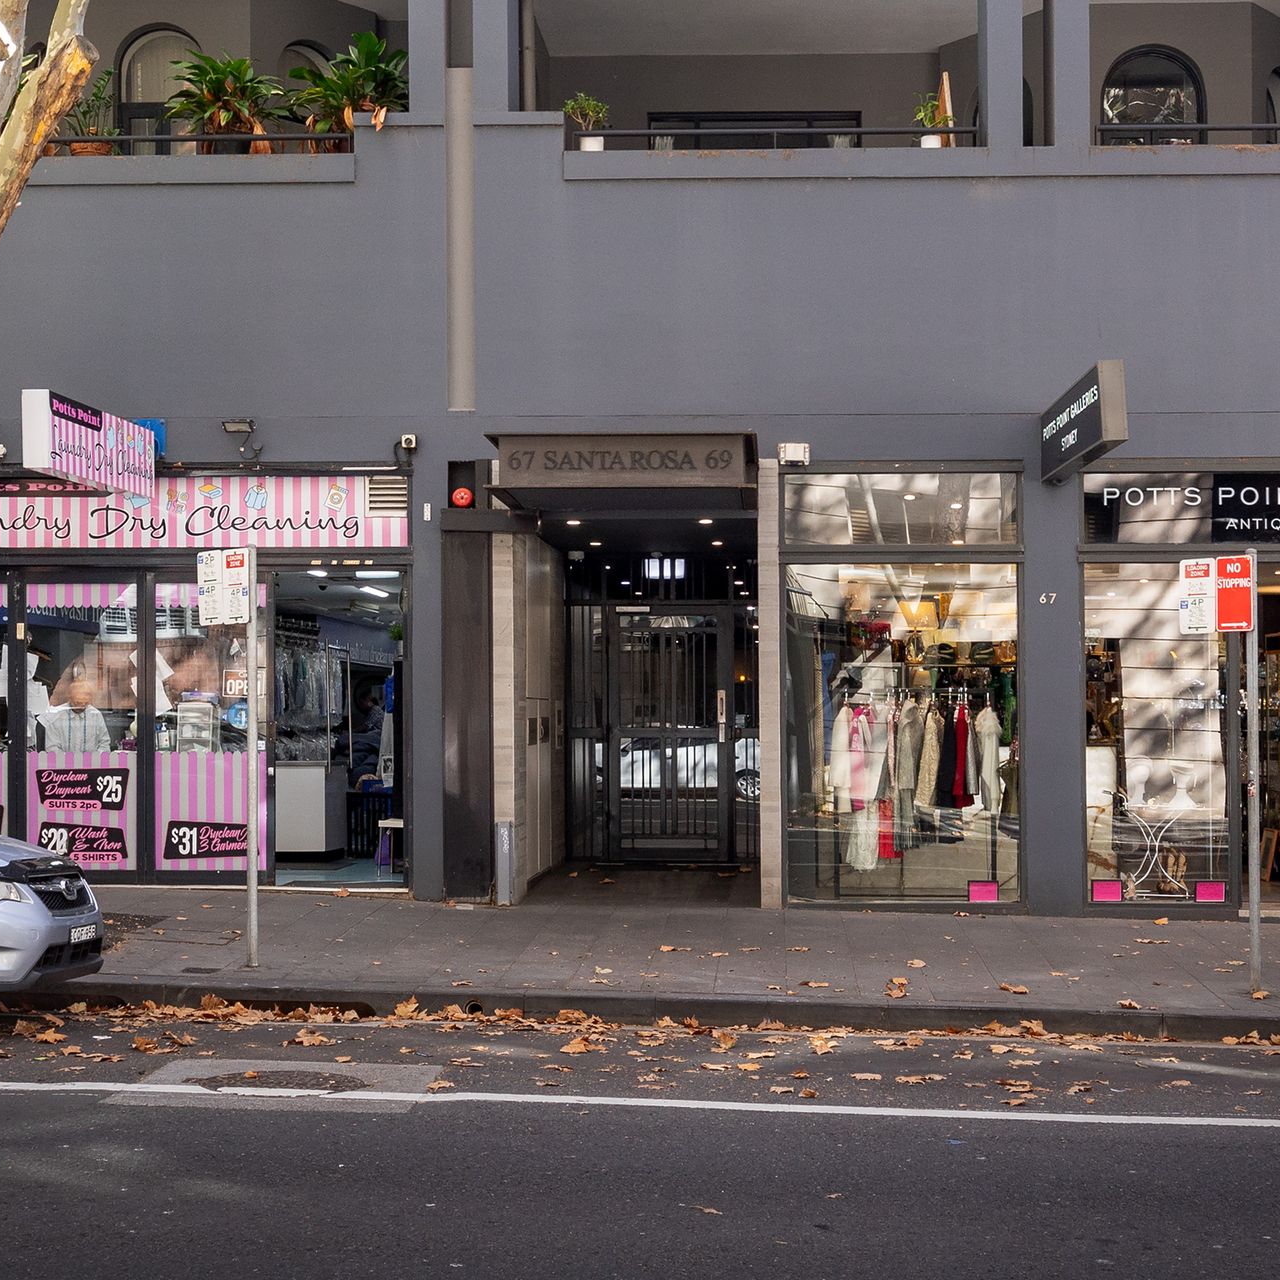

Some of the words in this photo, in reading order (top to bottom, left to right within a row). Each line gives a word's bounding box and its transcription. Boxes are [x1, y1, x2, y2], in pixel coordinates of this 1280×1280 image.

[51, 398, 77, 419] Potts
[77, 407, 102, 428] Point
[1056, 407, 1070, 431] POINT
[1070, 385, 1099, 419] GALLERIES
[50, 424, 92, 470] Laundry
[94, 443, 114, 476] Dry
[117, 449, 154, 489] Cleaning
[508, 449, 536, 470] 67
[543, 449, 626, 470] SANTA
[628, 449, 698, 470] ROSA
[704, 449, 734, 470] 69
[26, 478, 95, 492] Poin
[1102, 487, 1202, 506] POTTS
[88, 504, 167, 539] Dry
[185, 504, 359, 539] Cleaning
[1226, 563, 1242, 573] NO
[1217, 577, 1251, 589] STOPPING
[1039, 592, 1057, 604] 67
[226, 679, 261, 695] OPE
[40, 770, 88, 785] Dryclean
[44, 783, 92, 798] Daywear
[96, 775, 122, 802] $25
[48, 801, 77, 809] SUITS
[79, 801, 98, 810] 2pc
[68, 827, 109, 839] Wash
[171, 826, 197, 855] $31
[72, 838, 90, 851] &
[93, 838, 122, 850] Iron
[198, 839, 209, 852] 3
[210, 838, 248, 852] Garmen
[73, 853, 80, 861] 5
[81, 853, 118, 861] SHIRTS
